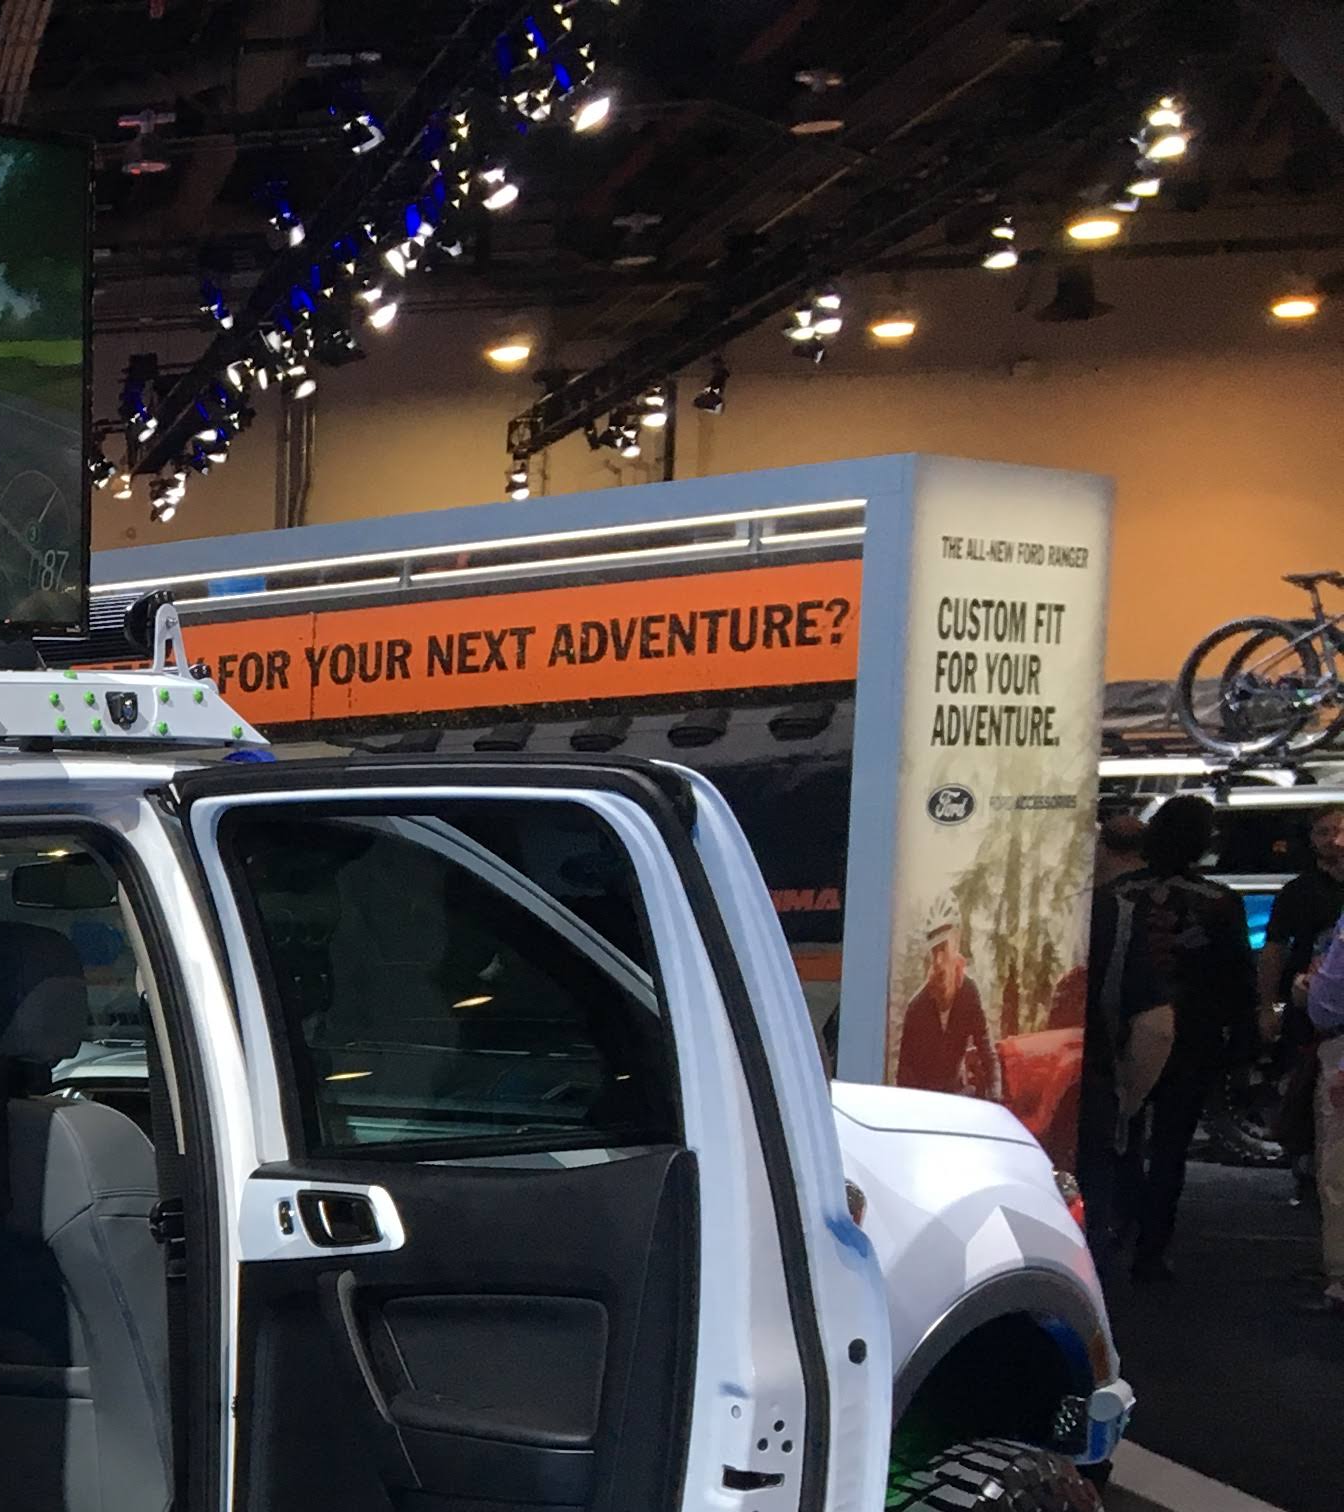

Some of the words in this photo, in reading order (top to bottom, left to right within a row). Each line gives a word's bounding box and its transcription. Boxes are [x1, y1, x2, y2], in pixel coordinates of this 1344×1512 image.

[942, 536, 962, 559] THE
[966, 539, 1013, 564] ALL-NEW
[1017, 542, 1044, 566] FORD
[1047, 545, 1089, 569] RANGER
[937, 597, 1027, 643] CUSTOM
[1034, 603, 1066, 644] FIT
[218, 649, 291, 695] FOR
[305, 638, 412, 687] YOUR
[426, 626, 536, 677] NEXT
[548, 597, 851, 667] ADVENTURE?
[934, 651, 978, 694] FOR
[985, 652, 1041, 695] YOUR
[930, 705, 1060, 747] ADVENTURE.
